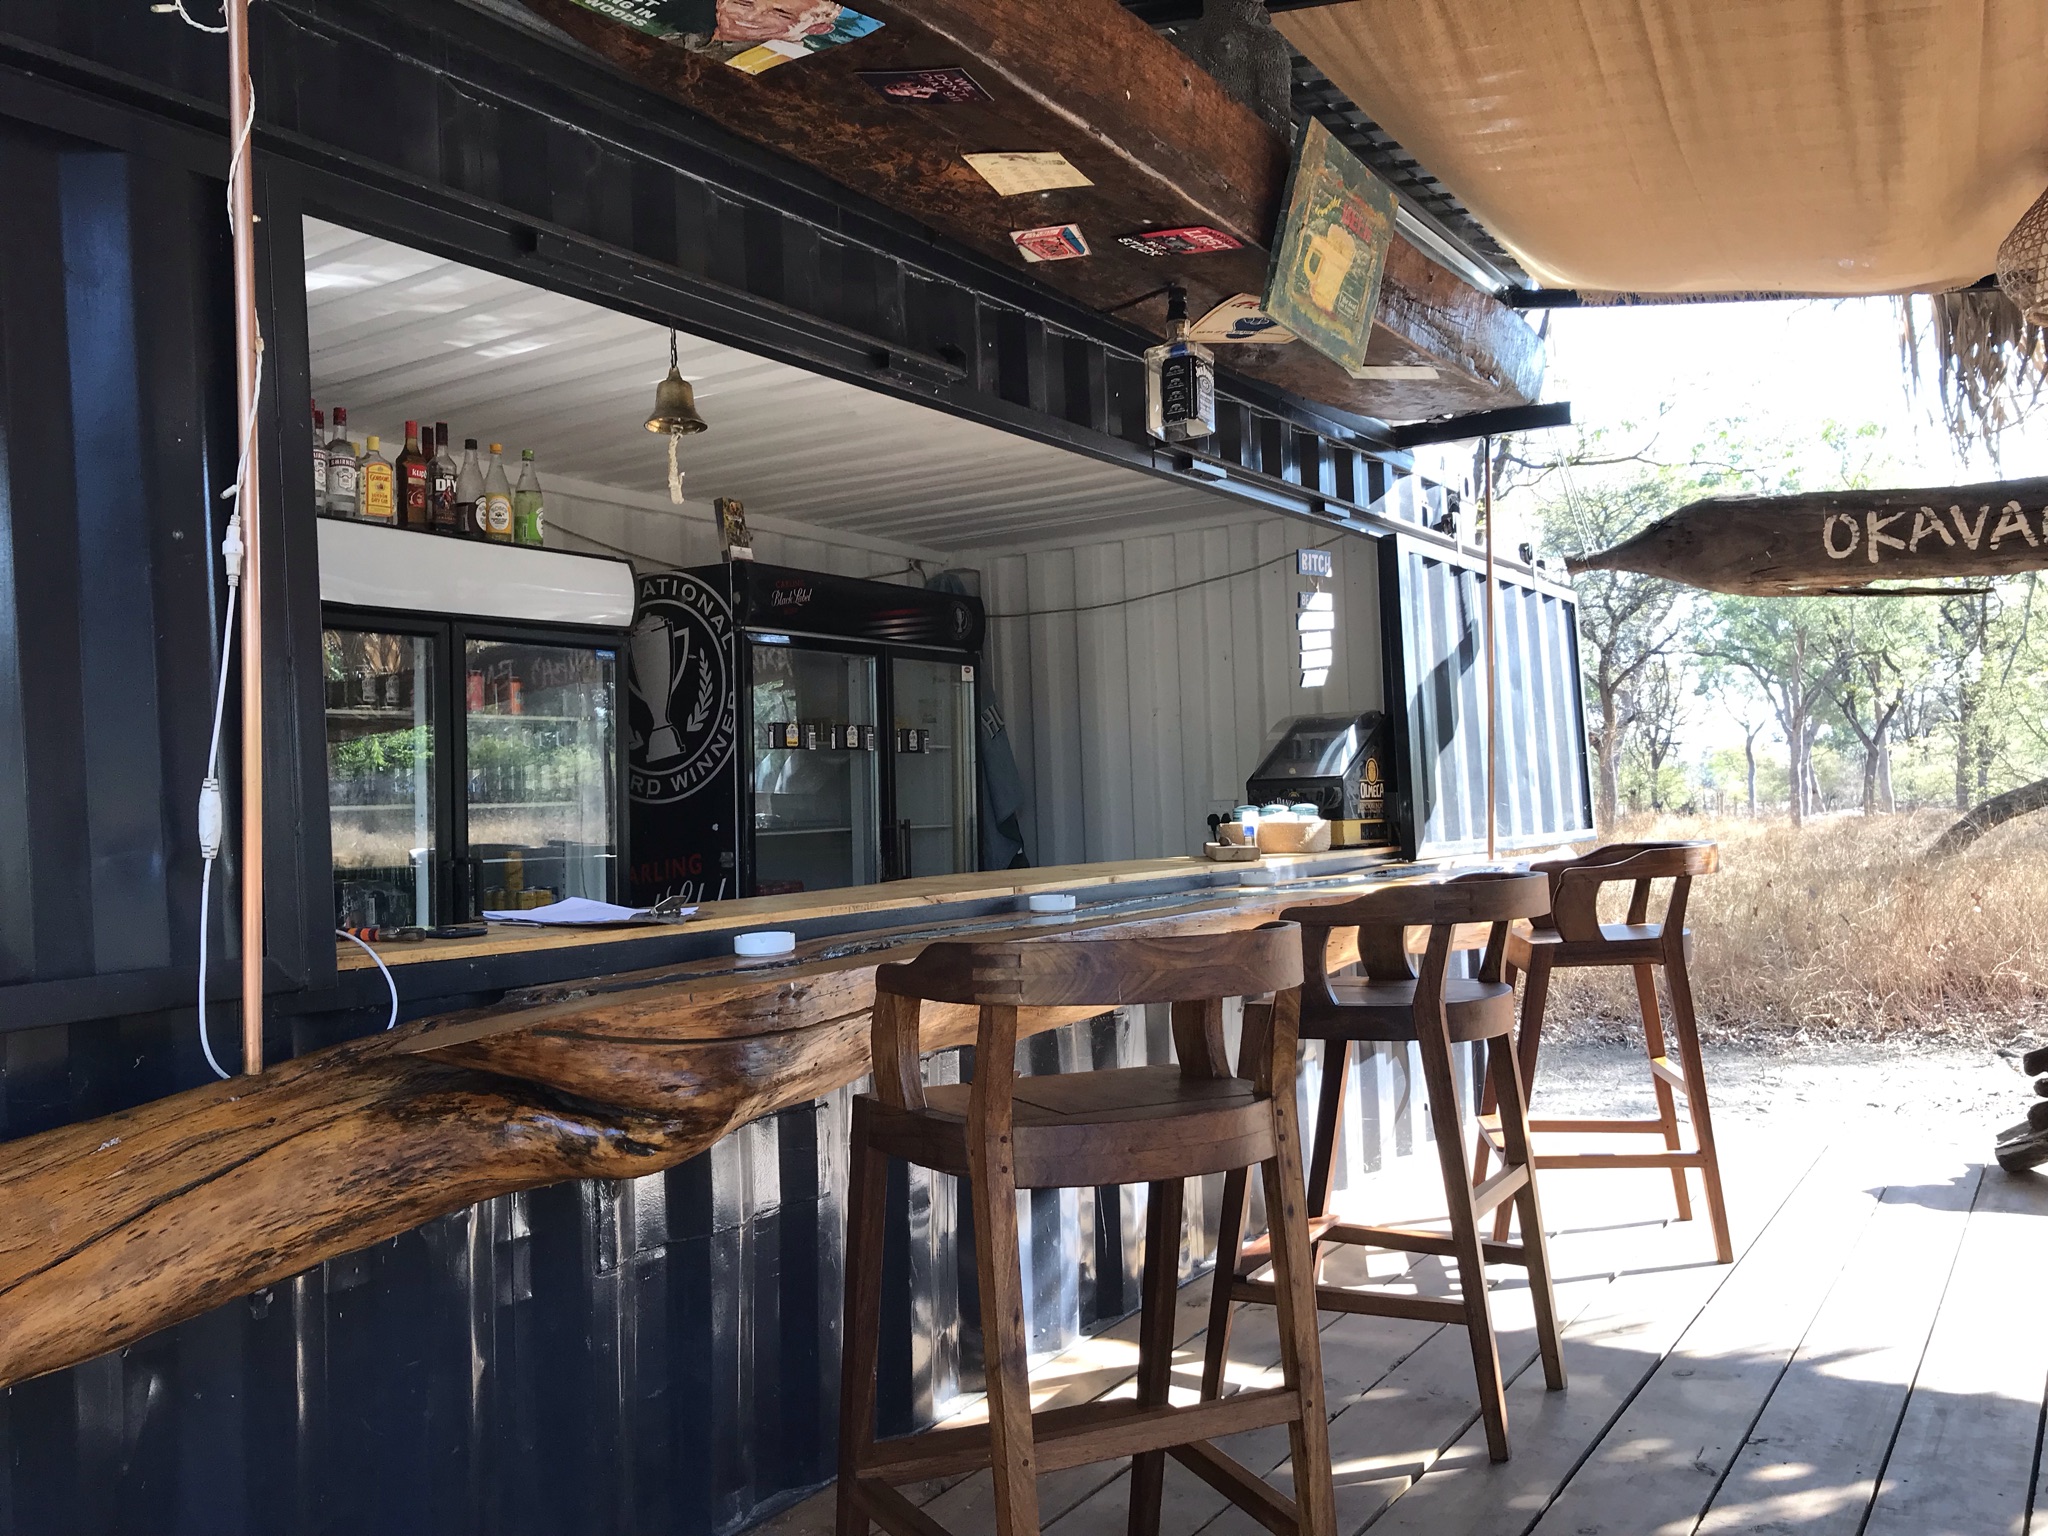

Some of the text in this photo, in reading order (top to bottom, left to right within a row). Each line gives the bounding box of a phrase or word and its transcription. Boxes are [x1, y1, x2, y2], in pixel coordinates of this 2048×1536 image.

[1183, 229, 1233, 250] LOST
[1823, 500, 2048, 564] OKAVA
[1360, 782, 1384, 799] OLMECA
